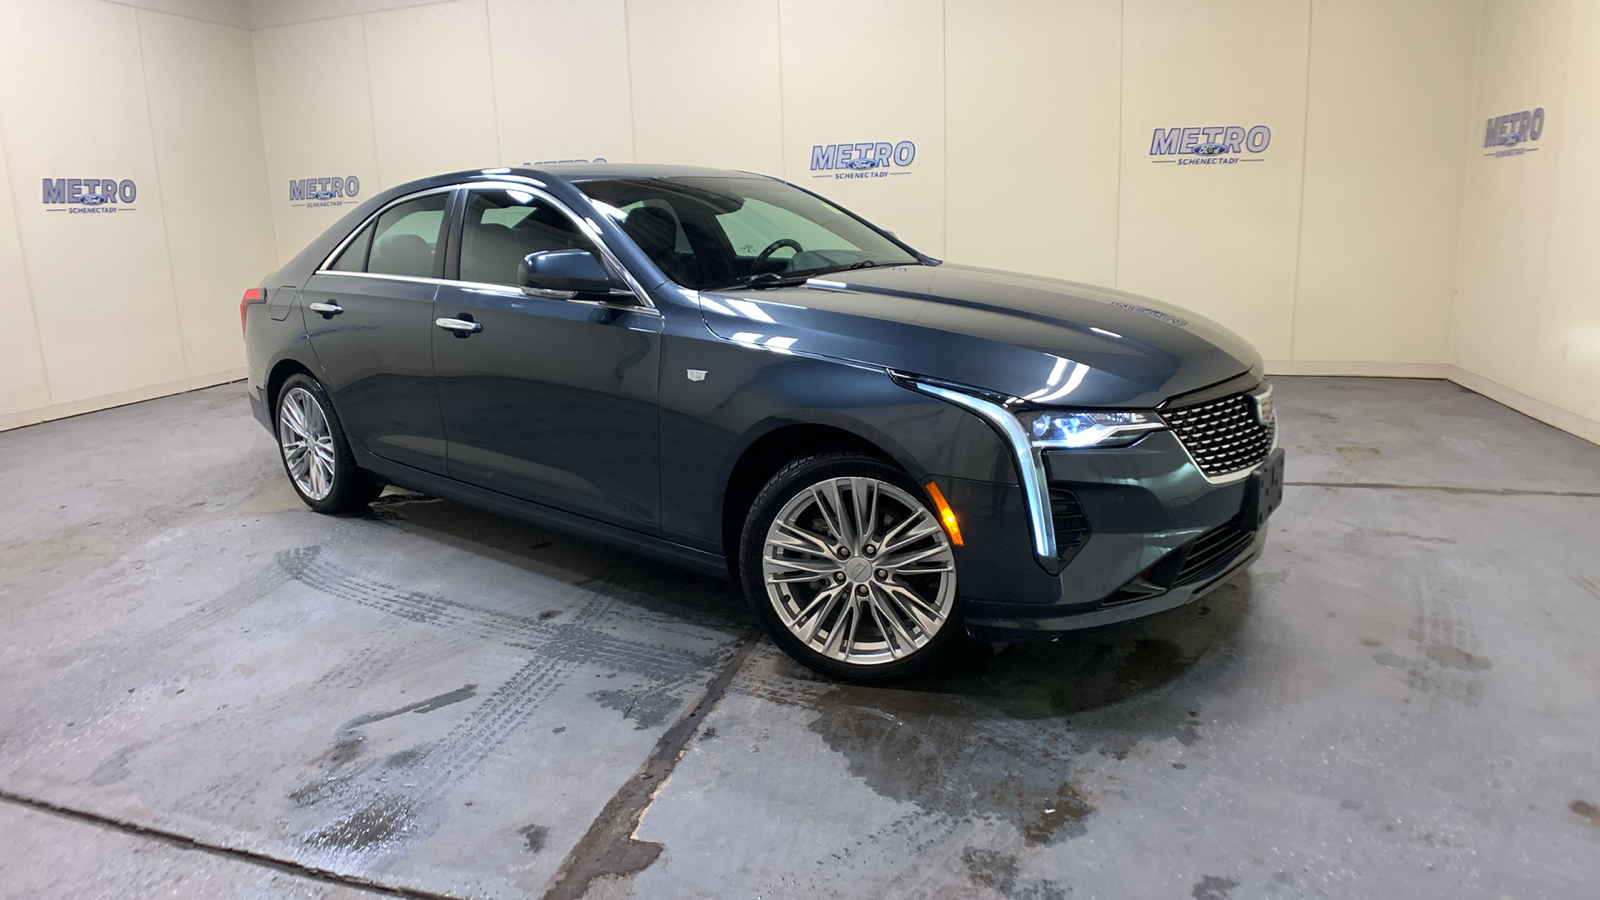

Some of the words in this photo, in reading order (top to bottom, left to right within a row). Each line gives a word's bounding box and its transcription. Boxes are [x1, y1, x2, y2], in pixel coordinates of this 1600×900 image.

[1149, 125, 1271, 155] METRO
[1484, 107, 1545, 148] METRO
[810, 140, 916, 170] METRO
[289, 175, 360, 201] METRO
[835, 171, 889, 179] SCHENECTADY
[42, 178, 137, 204] METRO
